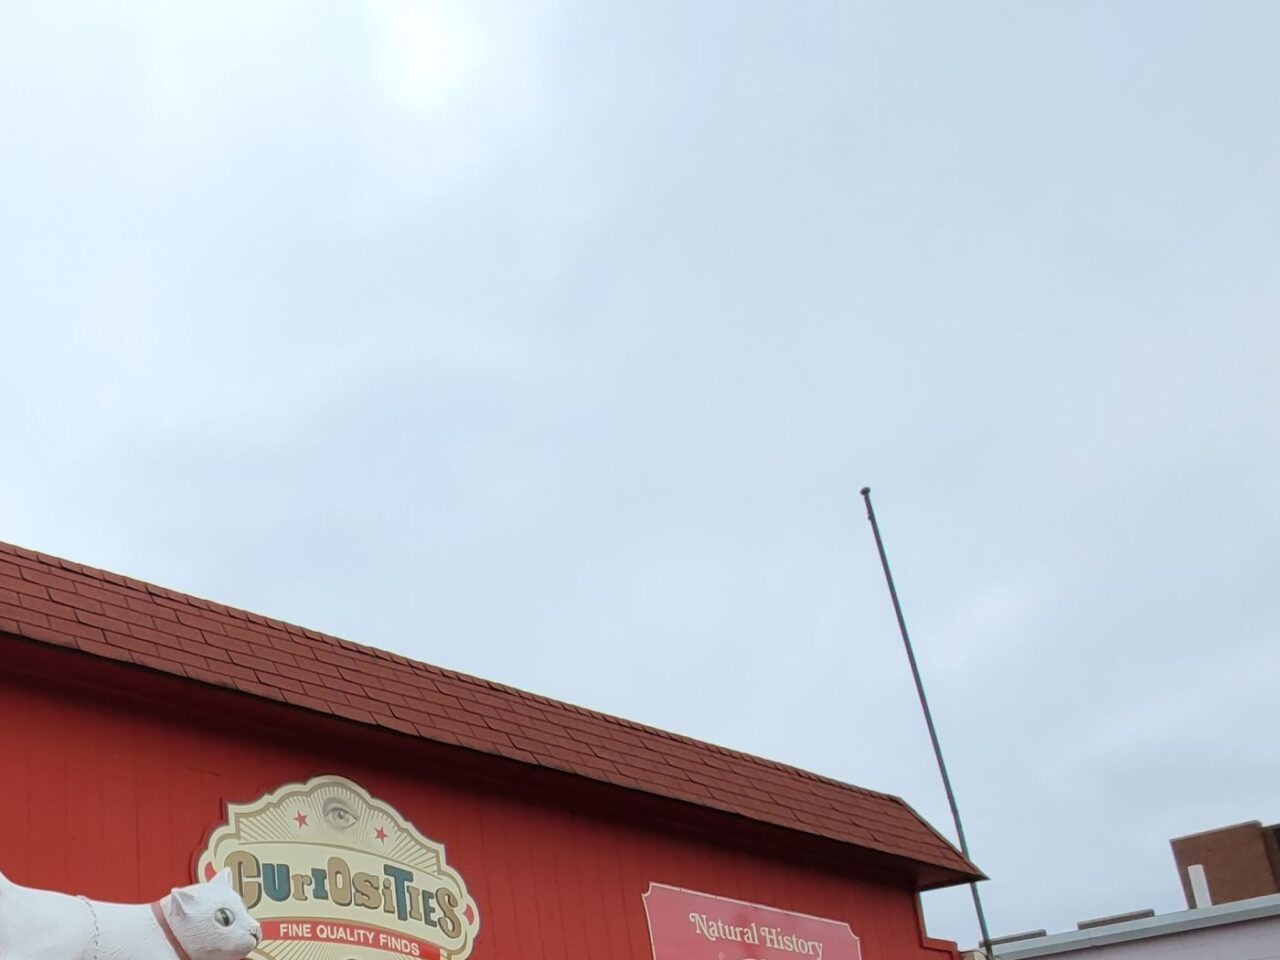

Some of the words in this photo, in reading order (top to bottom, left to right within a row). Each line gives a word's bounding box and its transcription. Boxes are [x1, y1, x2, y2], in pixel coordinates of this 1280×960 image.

[279, 923, 312, 938] FINE
[316, 925, 375, 945] QUALITY
[379, 933, 420, 956] FINDS
[689, 912, 760, 945] Natural
[760, 926, 823, 960] History
